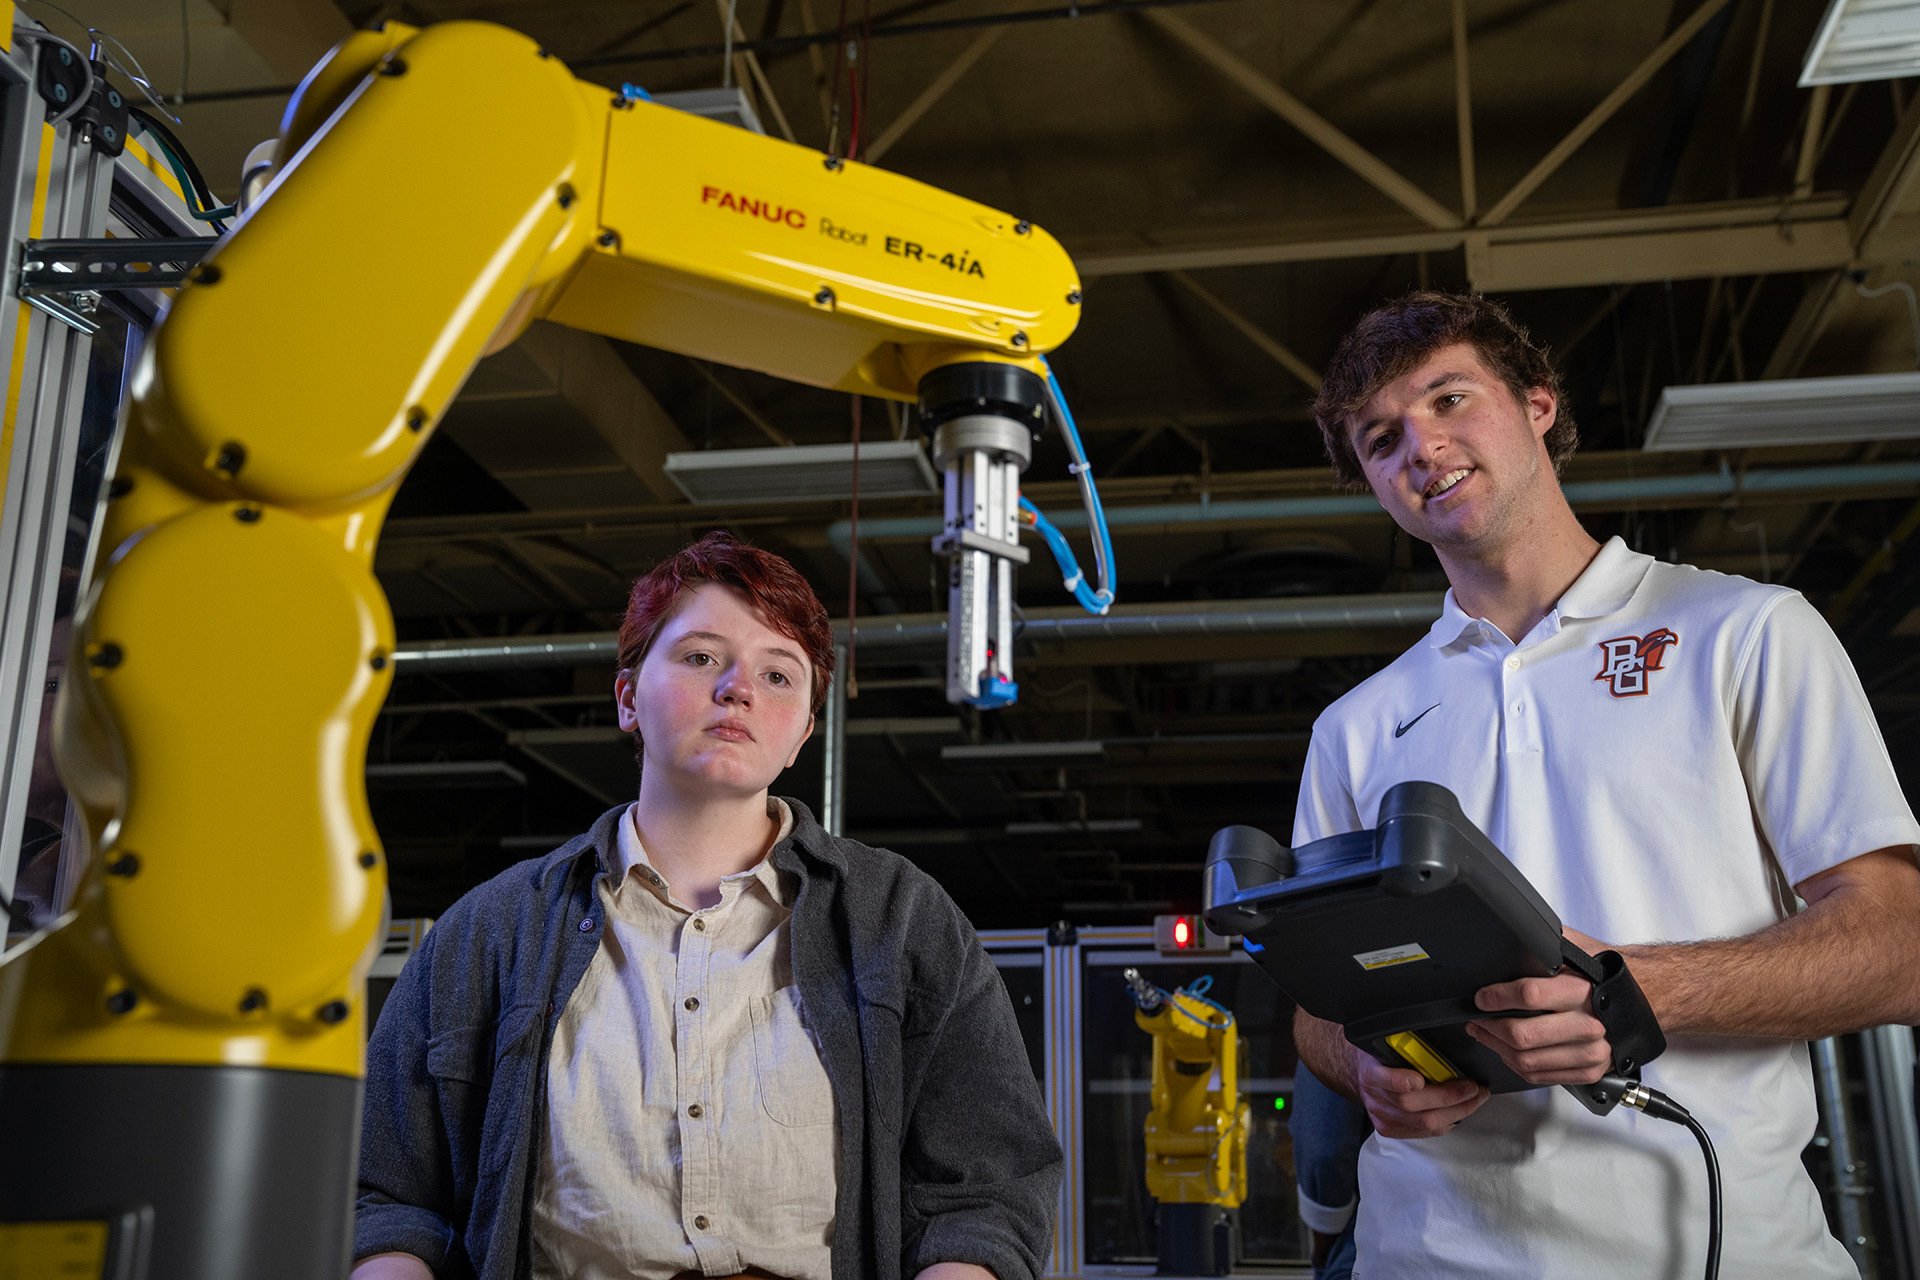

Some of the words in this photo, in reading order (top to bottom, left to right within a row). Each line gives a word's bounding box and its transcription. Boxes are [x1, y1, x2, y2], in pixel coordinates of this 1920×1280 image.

[702, 185, 806, 229] FANUC
[819, 217, 868, 246] Robot
[885, 235, 985, 279] ER-4iA
